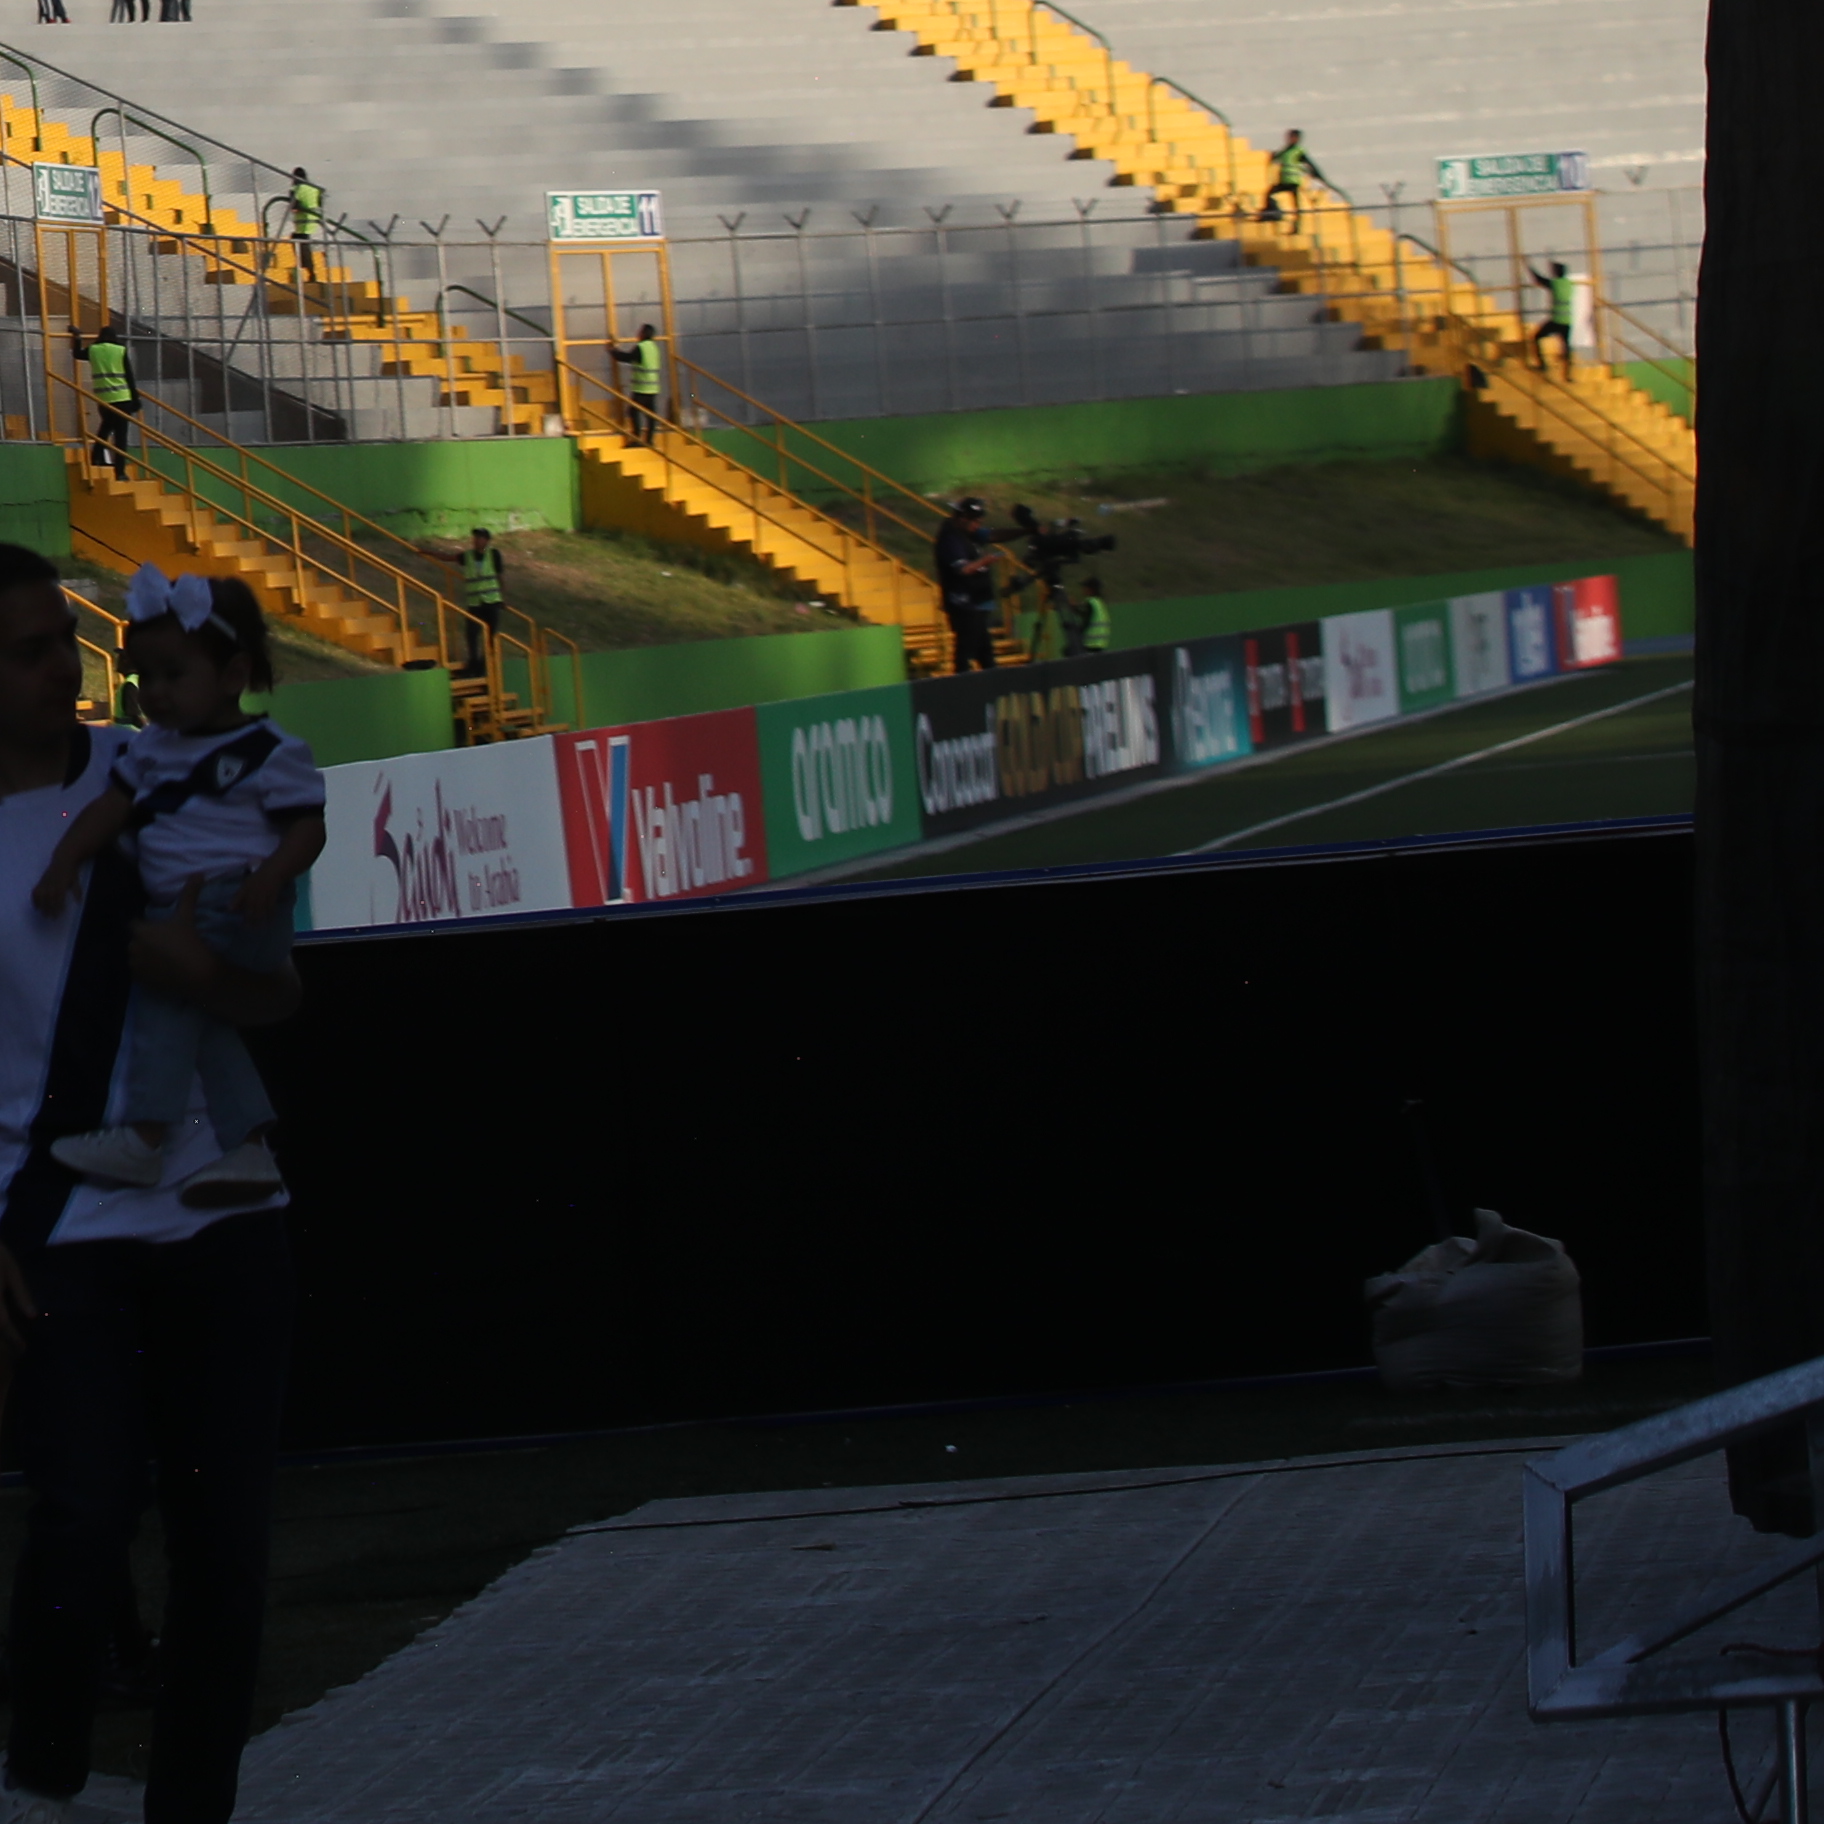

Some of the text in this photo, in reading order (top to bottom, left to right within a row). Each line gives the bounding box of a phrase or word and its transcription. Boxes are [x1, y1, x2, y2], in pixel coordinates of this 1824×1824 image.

[52, 169, 85, 192] SALIDA DE
[50, 194, 90, 216] EMERGENCIA
[577, 196, 632, 215] SALIDA DE
[792, 714, 893, 841] aramco
